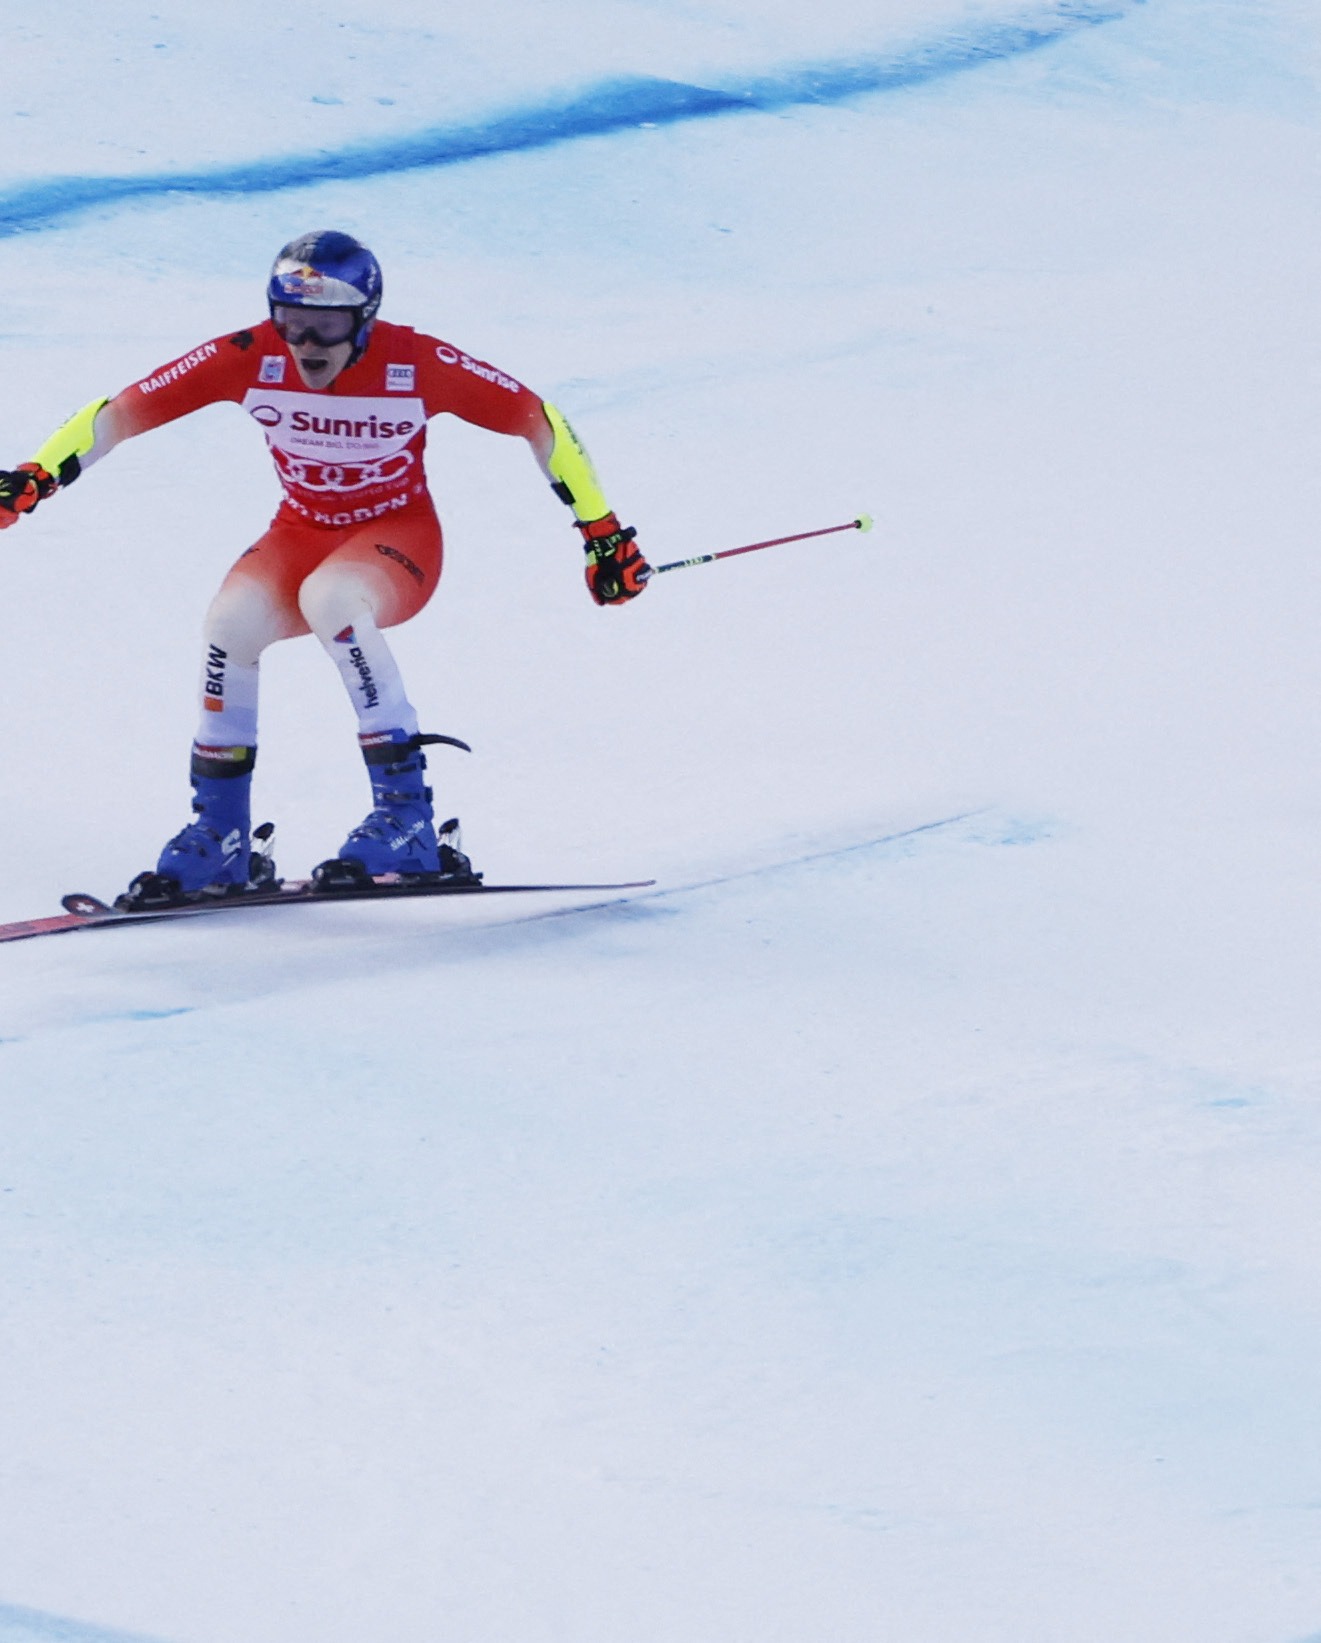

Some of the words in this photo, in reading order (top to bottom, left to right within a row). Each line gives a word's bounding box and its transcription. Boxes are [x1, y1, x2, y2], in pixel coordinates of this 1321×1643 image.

[139, 343, 218, 394] RAIFFEISEN
[460, 355, 520, 393] Sunrise
[290, 411, 414, 438] Sunrise
[205, 644, 227, 696] BKW
[349, 646, 379, 709] helvetia
